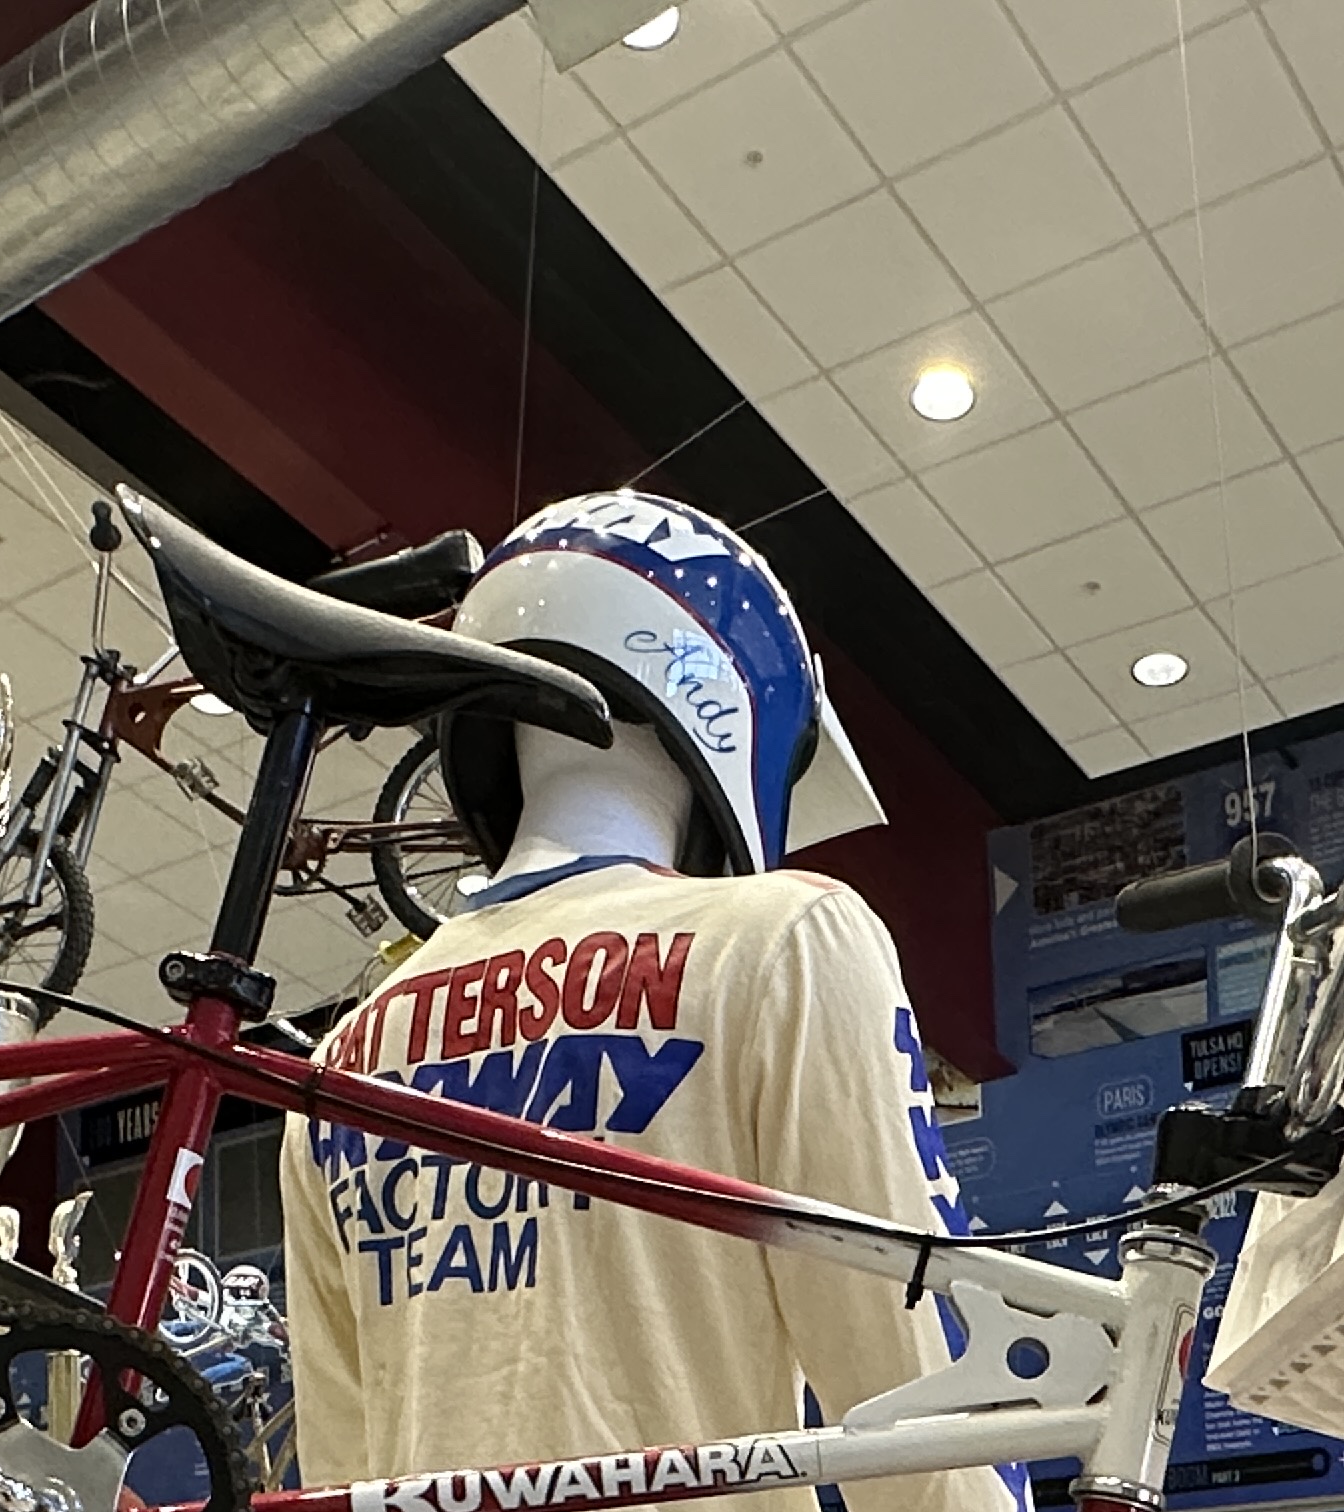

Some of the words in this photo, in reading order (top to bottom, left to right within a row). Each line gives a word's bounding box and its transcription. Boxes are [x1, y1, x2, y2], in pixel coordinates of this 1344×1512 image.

[326, 931, 695, 1073] PATTERSON
[1188, 1035, 1225, 1057] TULSA
[1103, 1084, 1146, 1108] PARIS
[358, 1217, 538, 1305] TEAM
